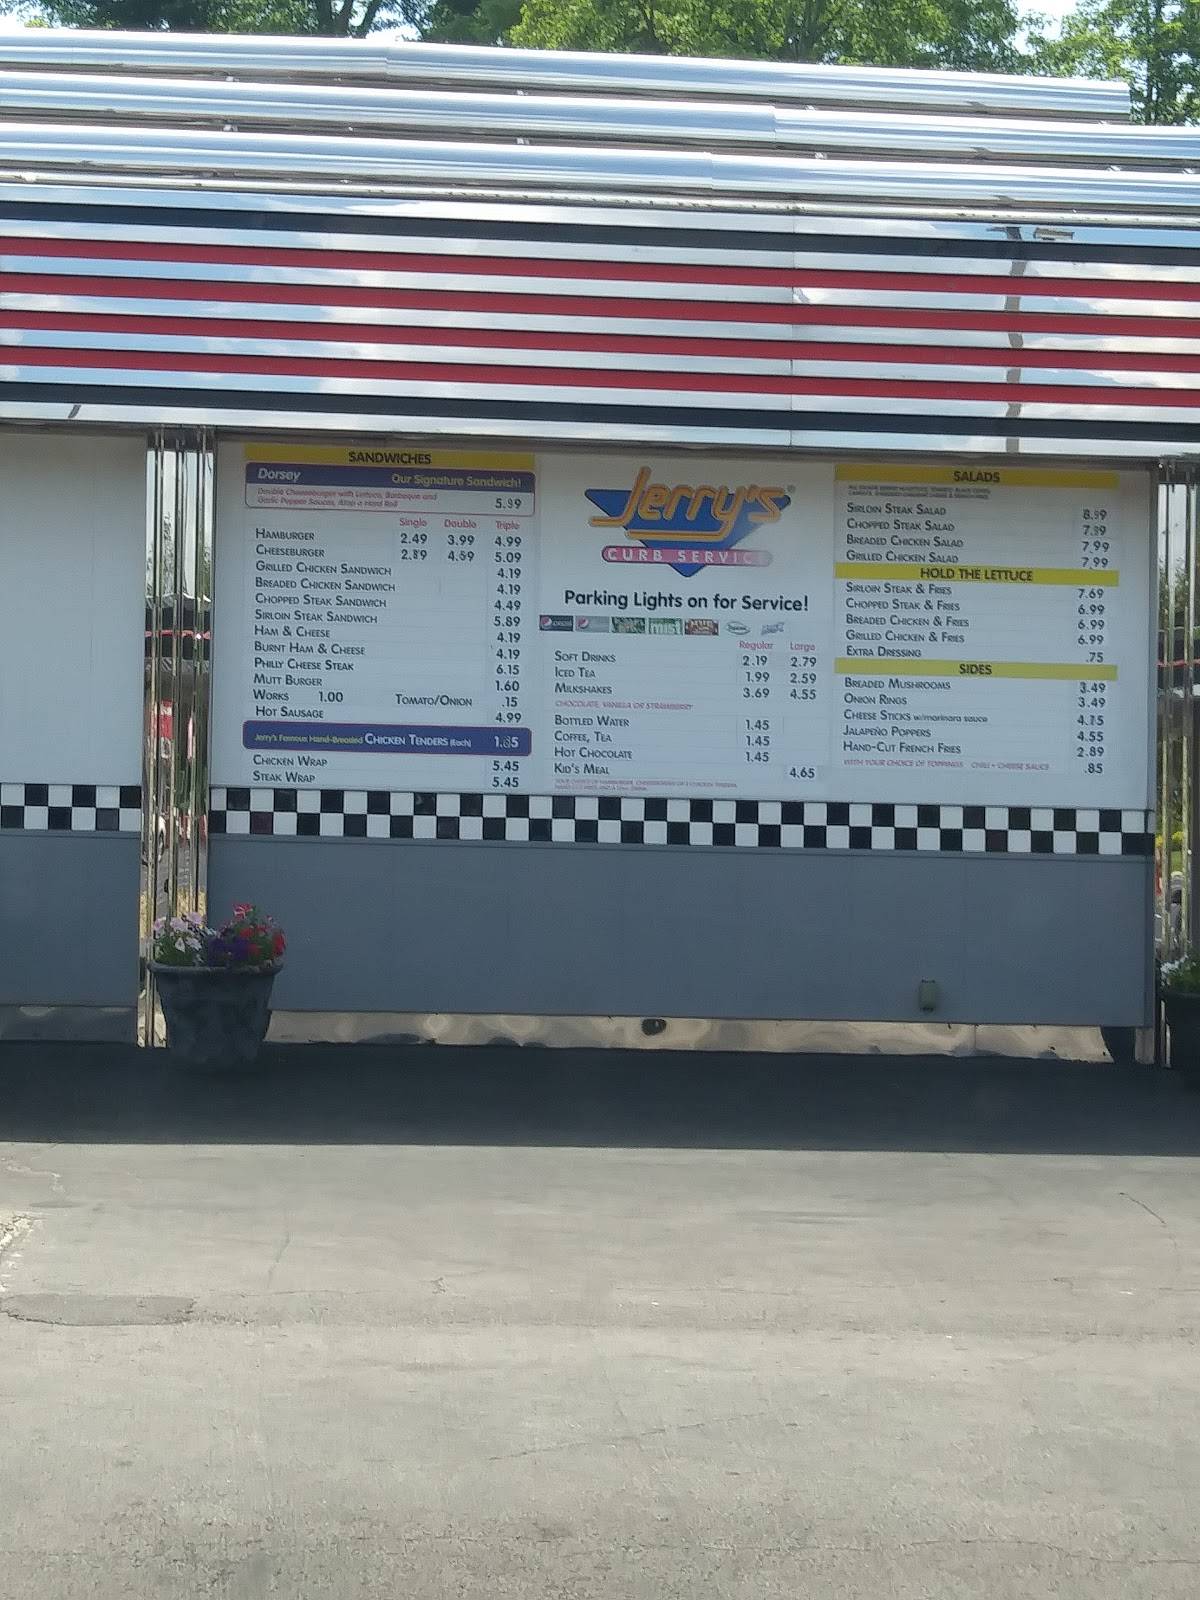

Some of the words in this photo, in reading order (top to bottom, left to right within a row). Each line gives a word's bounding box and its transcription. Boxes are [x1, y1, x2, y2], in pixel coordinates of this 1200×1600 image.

[348, 451, 432, 464] SANDWICHES
[258, 468, 301, 482] Dorsey
[392, 474, 411, 484] Our
[414, 475, 464, 487] Signature
[953, 471, 1000, 483] SALADS
[587, 466, 785, 541] Jerry's
[400, 518, 427, 528] Single
[444, 519, 476, 528] Double
[496, 520, 520, 531] Triple
[400, 533, 428, 544] 2.49
[447, 535, 475, 546] 3.99
[494, 536, 522, 547] 4.99
[1081, 540, 1110, 553] 7.99
[495, 552, 521, 563] 5.09
[606, 548, 663, 562] CURB
[677, 549, 767, 566] SERVIC
[1081, 556, 1109, 569] 7.99
[497, 568, 521, 579] 4.19
[920, 568, 955, 579] HOLD
[959, 568, 981, 580] THE
[984, 569, 1033, 582] LETTUCE
[496, 584, 521, 595] 4.19
[915, 583, 925, 594] &
[1077, 588, 1104, 599] 7.69
[494, 600, 521, 611] 4.49
[565, 590, 627, 609] Parking
[634, 592, 682, 610] Lights
[687, 597, 707, 608] on
[714, 593, 737, 609] for
[742, 595, 808, 611] Service!
[923, 599, 934, 610] &
[1078, 604, 1105, 615] 6.99
[493, 616, 520, 627] 5.89
[932, 615, 943, 627] &
[1078, 619, 1105, 630] 6.99
[282, 626, 292, 636] &
[497, 632, 521, 643] 4.19
[928, 631, 938, 642] &
[1078, 634, 1104, 645] 6.99
[317, 643, 327, 654] &
[496, 648, 520, 660] 4.19
[739, 640, 773, 650] Regular
[790, 642, 816, 652] Large
[742, 655, 768, 667] 2.19
[790, 657, 817, 668] 2.79
[1086, 651, 1104, 663] .75
[496, 664, 520, 675] 6.15
[959, 663, 992, 675] SIDES
[745, 672, 770, 683] 1.99
[790, 673, 817, 684] 2.59
[495, 680, 520, 691] 1.60
[1080, 682, 1106, 693] 3.49
[318, 691, 344, 703] 1.00
[742, 688, 770, 698] 3.69
[790, 689, 817, 700] 4.55
[501, 696, 518, 707] .15
[1078, 697, 1106, 708] 3.49
[495, 712, 522, 723] 4.99
[745, 719, 770, 731] 1.45
[746, 735, 770, 746] 1.45
[1077, 731, 1104, 742] 4.55
[745, 751, 769, 762] 1.45
[1077, 746, 1104, 757] 2.89
[492, 760, 520, 772] 5.45
[1084, 763, 1103, 774] .85
[789, 767, 815, 779] 4.65
[492, 776, 519, 788] 5.45
